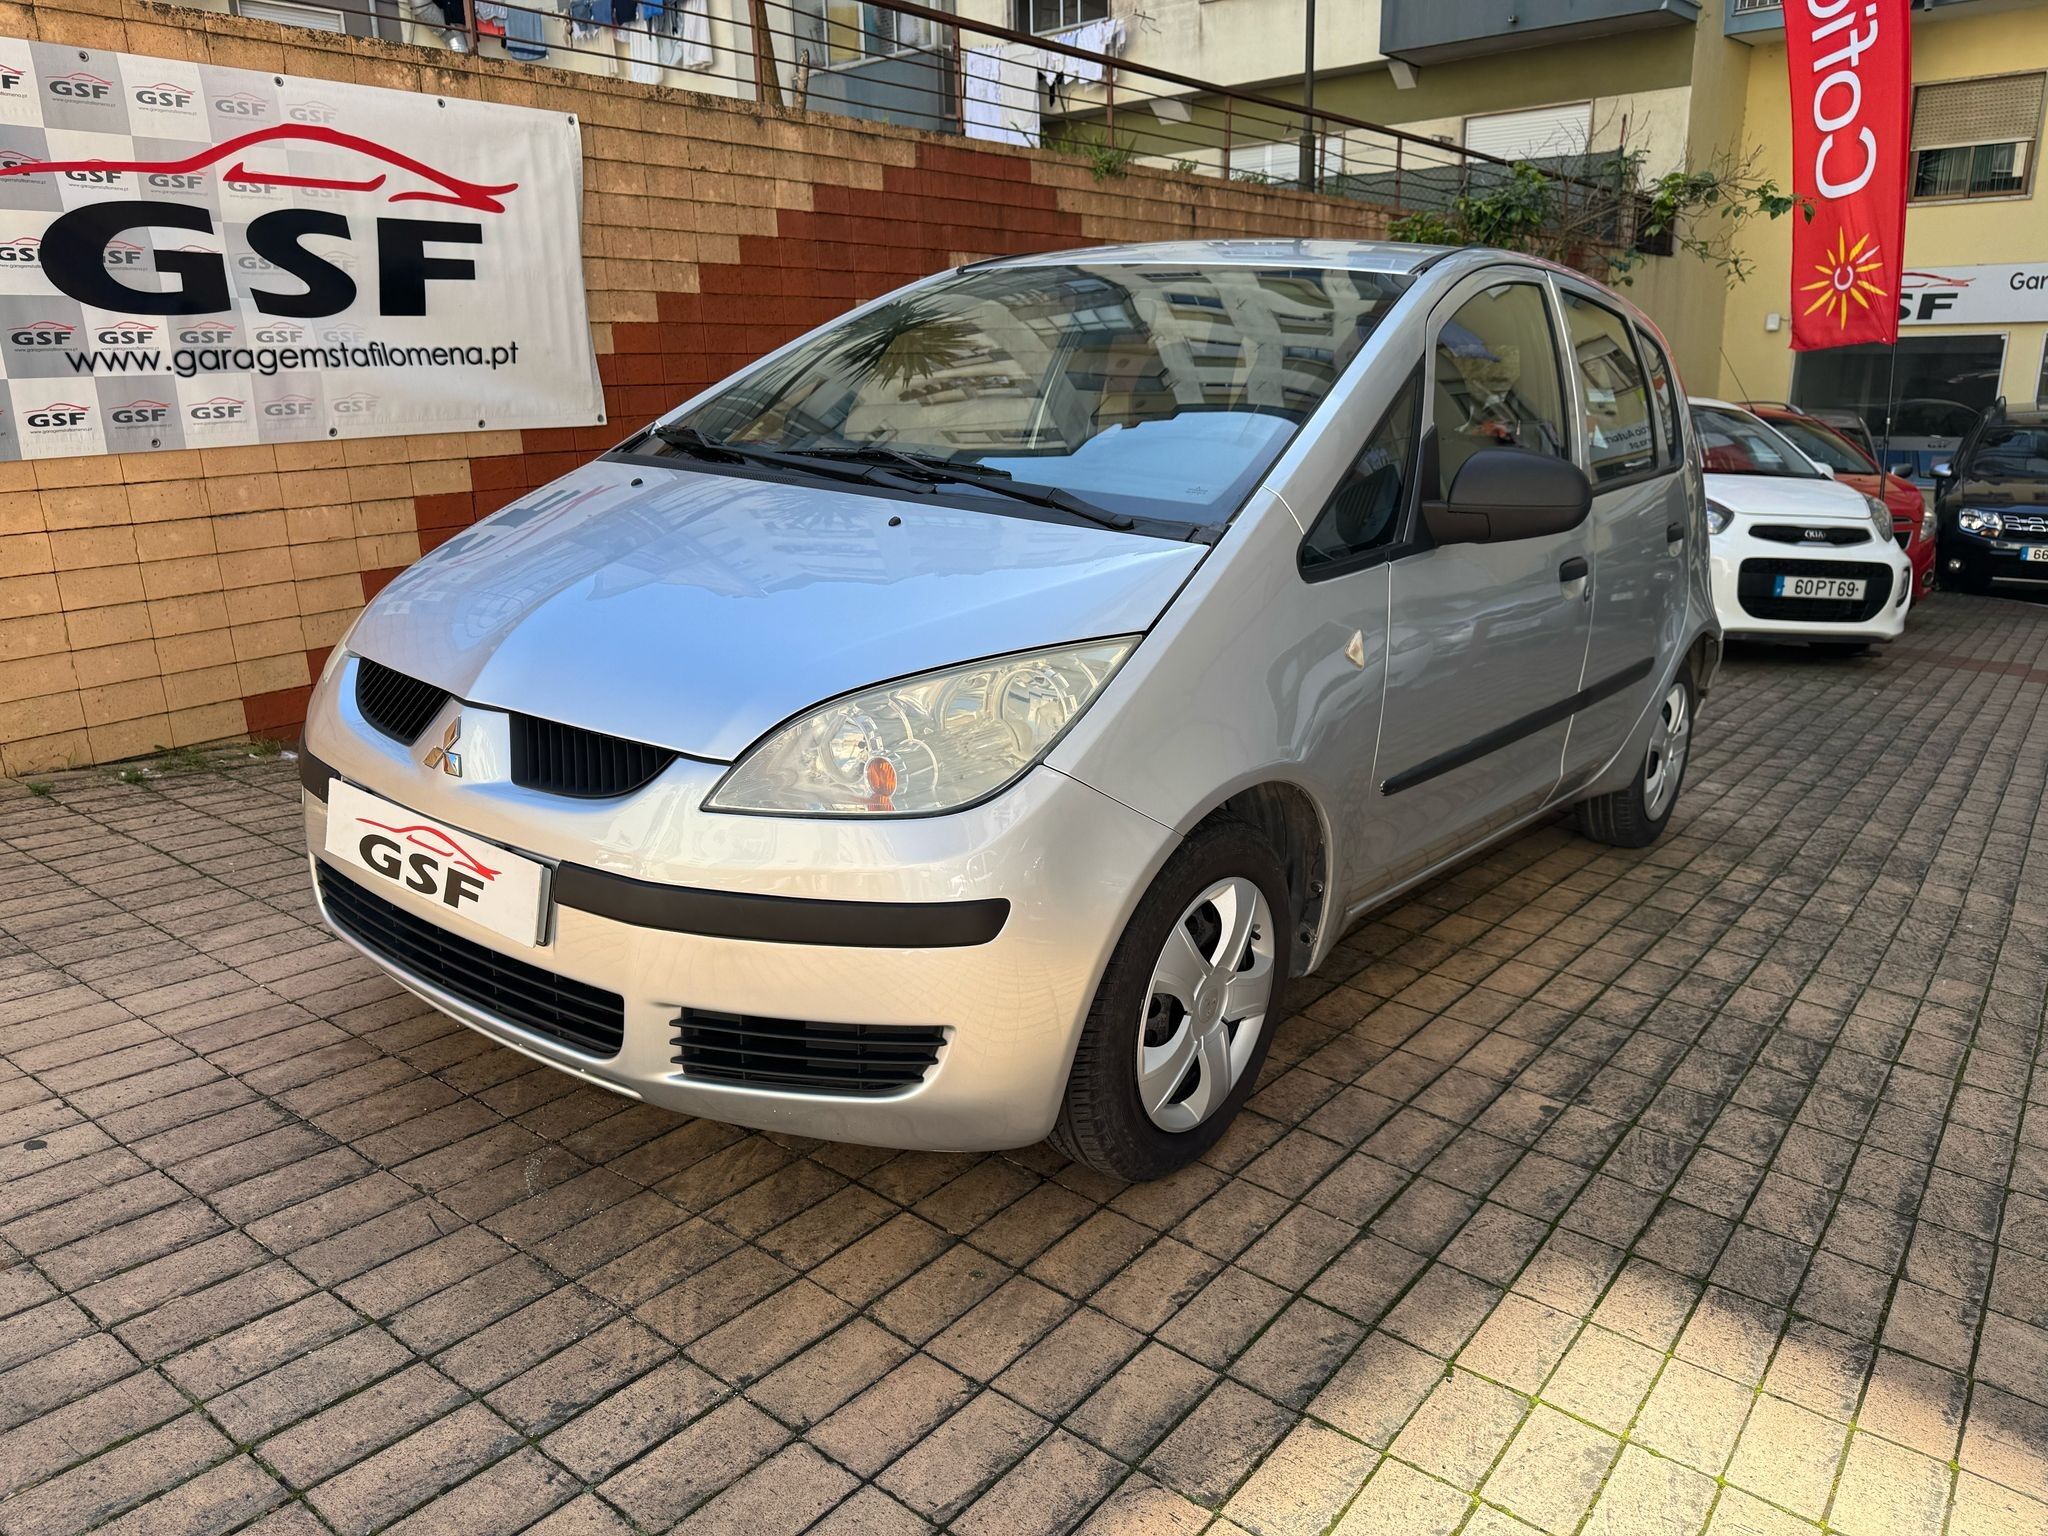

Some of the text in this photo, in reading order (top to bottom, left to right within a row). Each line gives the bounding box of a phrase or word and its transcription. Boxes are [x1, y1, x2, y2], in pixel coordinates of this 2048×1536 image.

[49, 81, 109, 99] GSF
[136, 91, 191, 108] GSF
[215, 100, 266, 116] GSF
[148, 174, 203, 189] GSF
[0, 247, 41, 261] GS
[40, 201, 483, 318] GSF
[103, 250, 141, 264] SF
[11, 331, 71, 345] GSF
[98, 331, 153, 344] GSF
[180, 331, 232, 344] GSF
[256, 331, 303, 343] GSF
[65, 341, 519, 378] www.garagemstafilomena.pt
[112, 409, 167, 423] GSF
[191, 406, 242, 419] GSF
[264, 403, 313, 416] GSF
[27, 412, 86, 427] GSF
[359, 834, 485, 908] GSF
